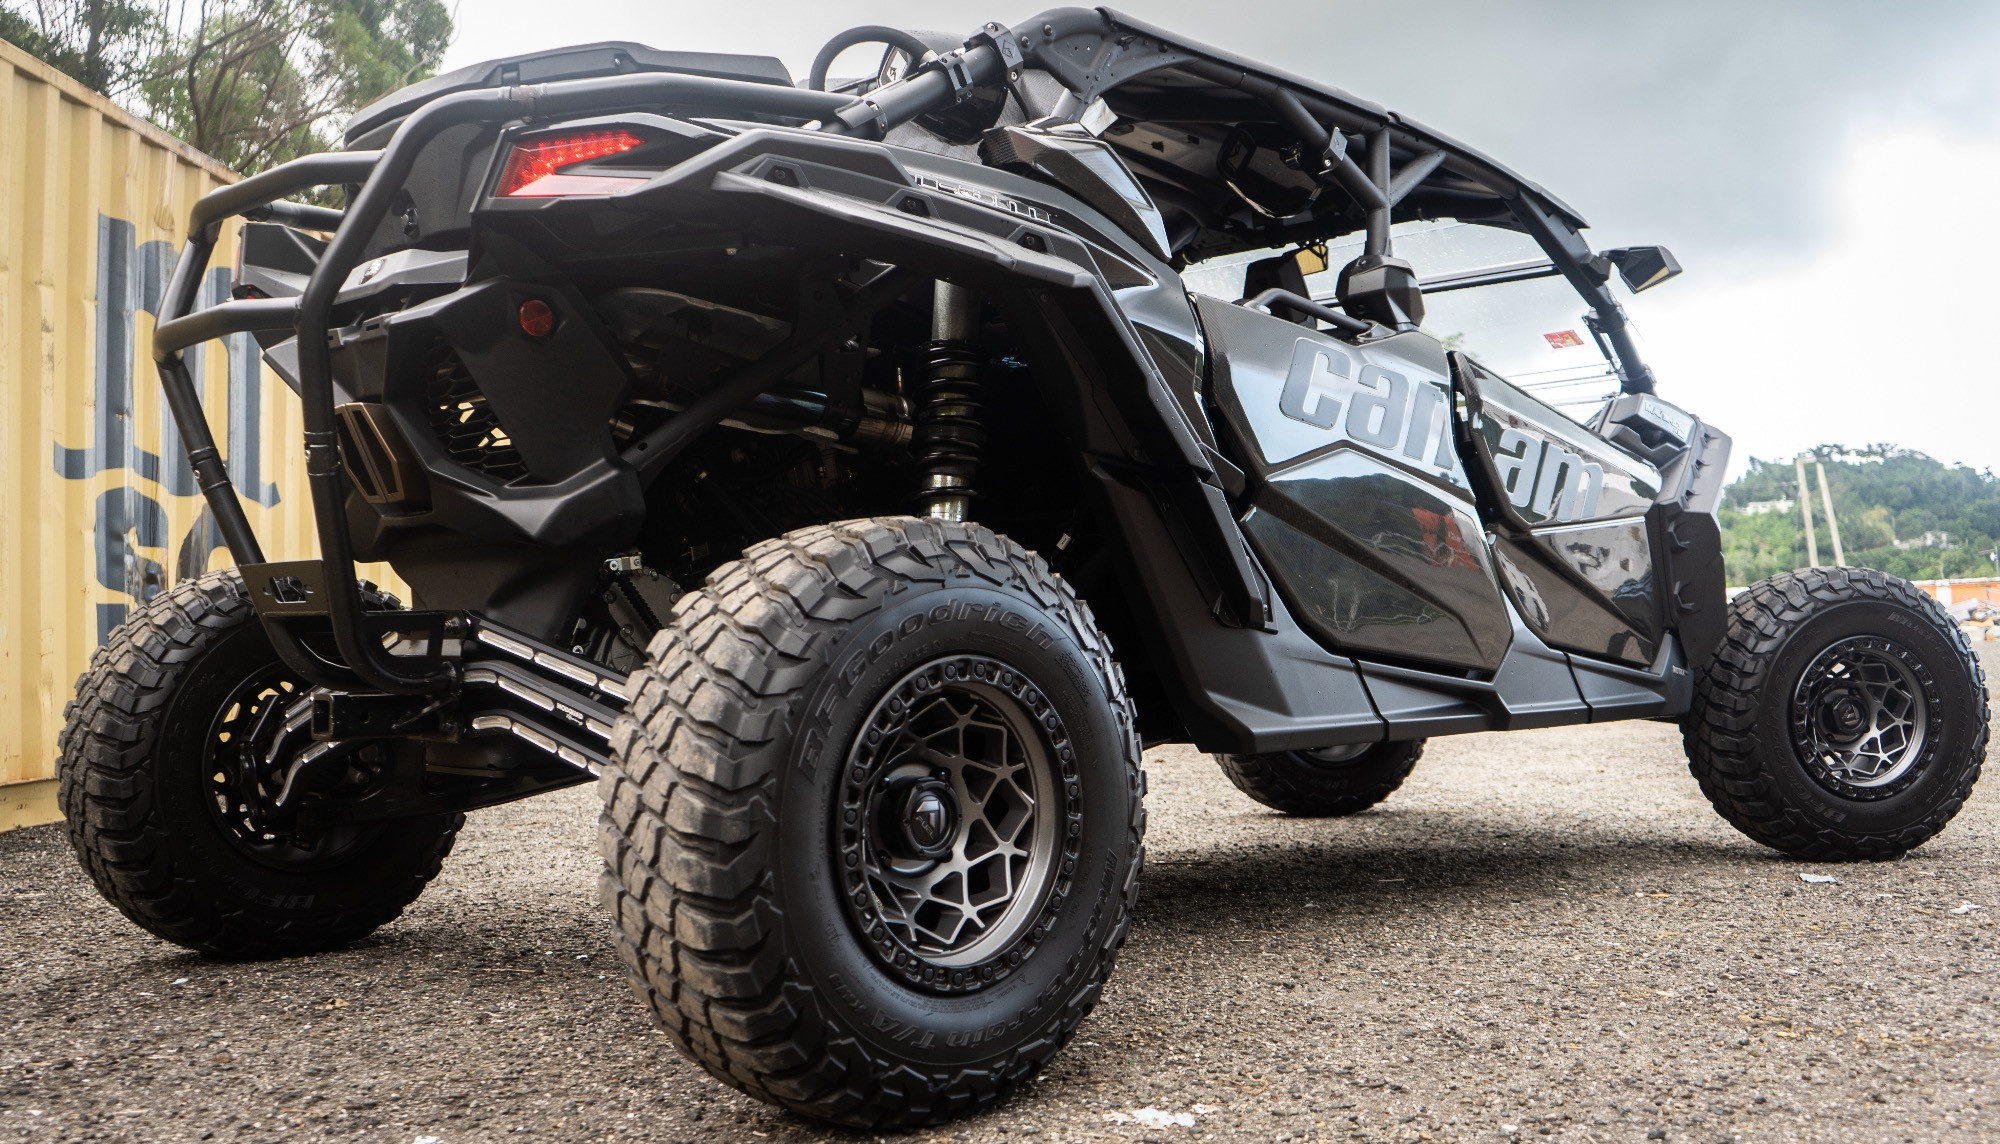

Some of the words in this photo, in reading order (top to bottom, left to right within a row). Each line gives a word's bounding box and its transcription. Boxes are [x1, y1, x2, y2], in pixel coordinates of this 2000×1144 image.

[798, 597, 1056, 785] BFGoodrich
[915, 814, 935, 840] FUEL
[946, 847, 1119, 1050] Mud-Terrain
[870, 1008, 938, 1050] T/A
